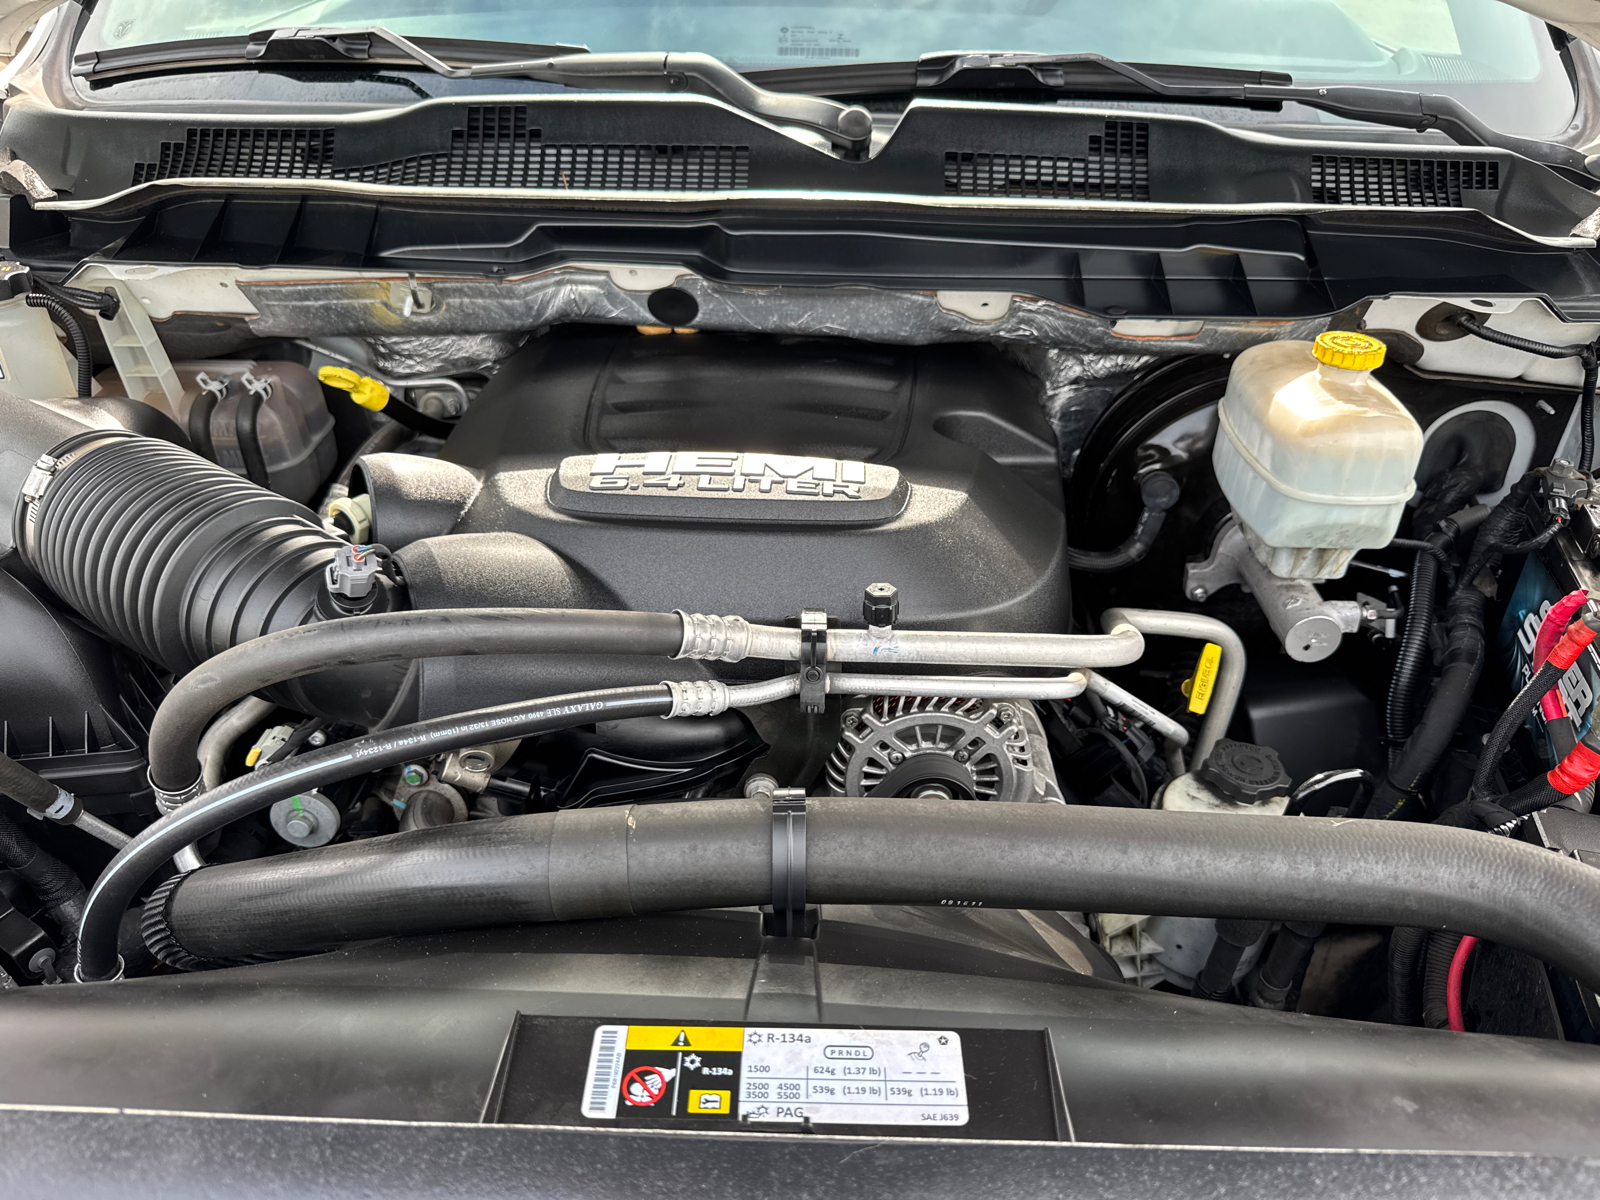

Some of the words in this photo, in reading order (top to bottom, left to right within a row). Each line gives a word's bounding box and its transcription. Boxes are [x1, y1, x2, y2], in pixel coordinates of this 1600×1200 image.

[589, 451, 866, 484] HEMI
[696, 474, 862, 499] LITER
[546, 707, 561, 717] SLE
[563, 701, 604, 715] GALAXY
[491, 716, 512, 727] HOSE
[513, 713, 526, 722] A/C
[429, 726, 459, 739] (10mm)
[469, 722, 489, 732] 13/32
[397, 734, 427, 746] R-134a
[766, 1032, 812, 1044] R-134a
[829, 1048, 869, 1057] PRNDL
[701, 1066, 734, 1076] R-134a
[747, 1064, 771, 1073] 1500
[813, 1066, 836, 1076] 624g
[842, 1066, 867, 1077] (1.37
[868, 1067, 882, 1077] lb)
[745, 1082, 770, 1091] 2500
[777, 1082, 801, 1091] 4500
[812, 1085, 836, 1096] 539g
[842, 1085, 867, 1097] (1.19
[868, 1086, 882, 1097] lb)
[745, 1091, 769, 1100] 3500
[777, 1091, 801, 1100] 5500
[889, 1087, 913, 1098] 539g
[919, 1087, 944, 1097] (1.19
[945, 1087, 959, 1098] lb)
[776, 1106, 804, 1118] PAG
[920, 1113, 938, 1122] SAE
[938, 1113, 960, 1122] J639
